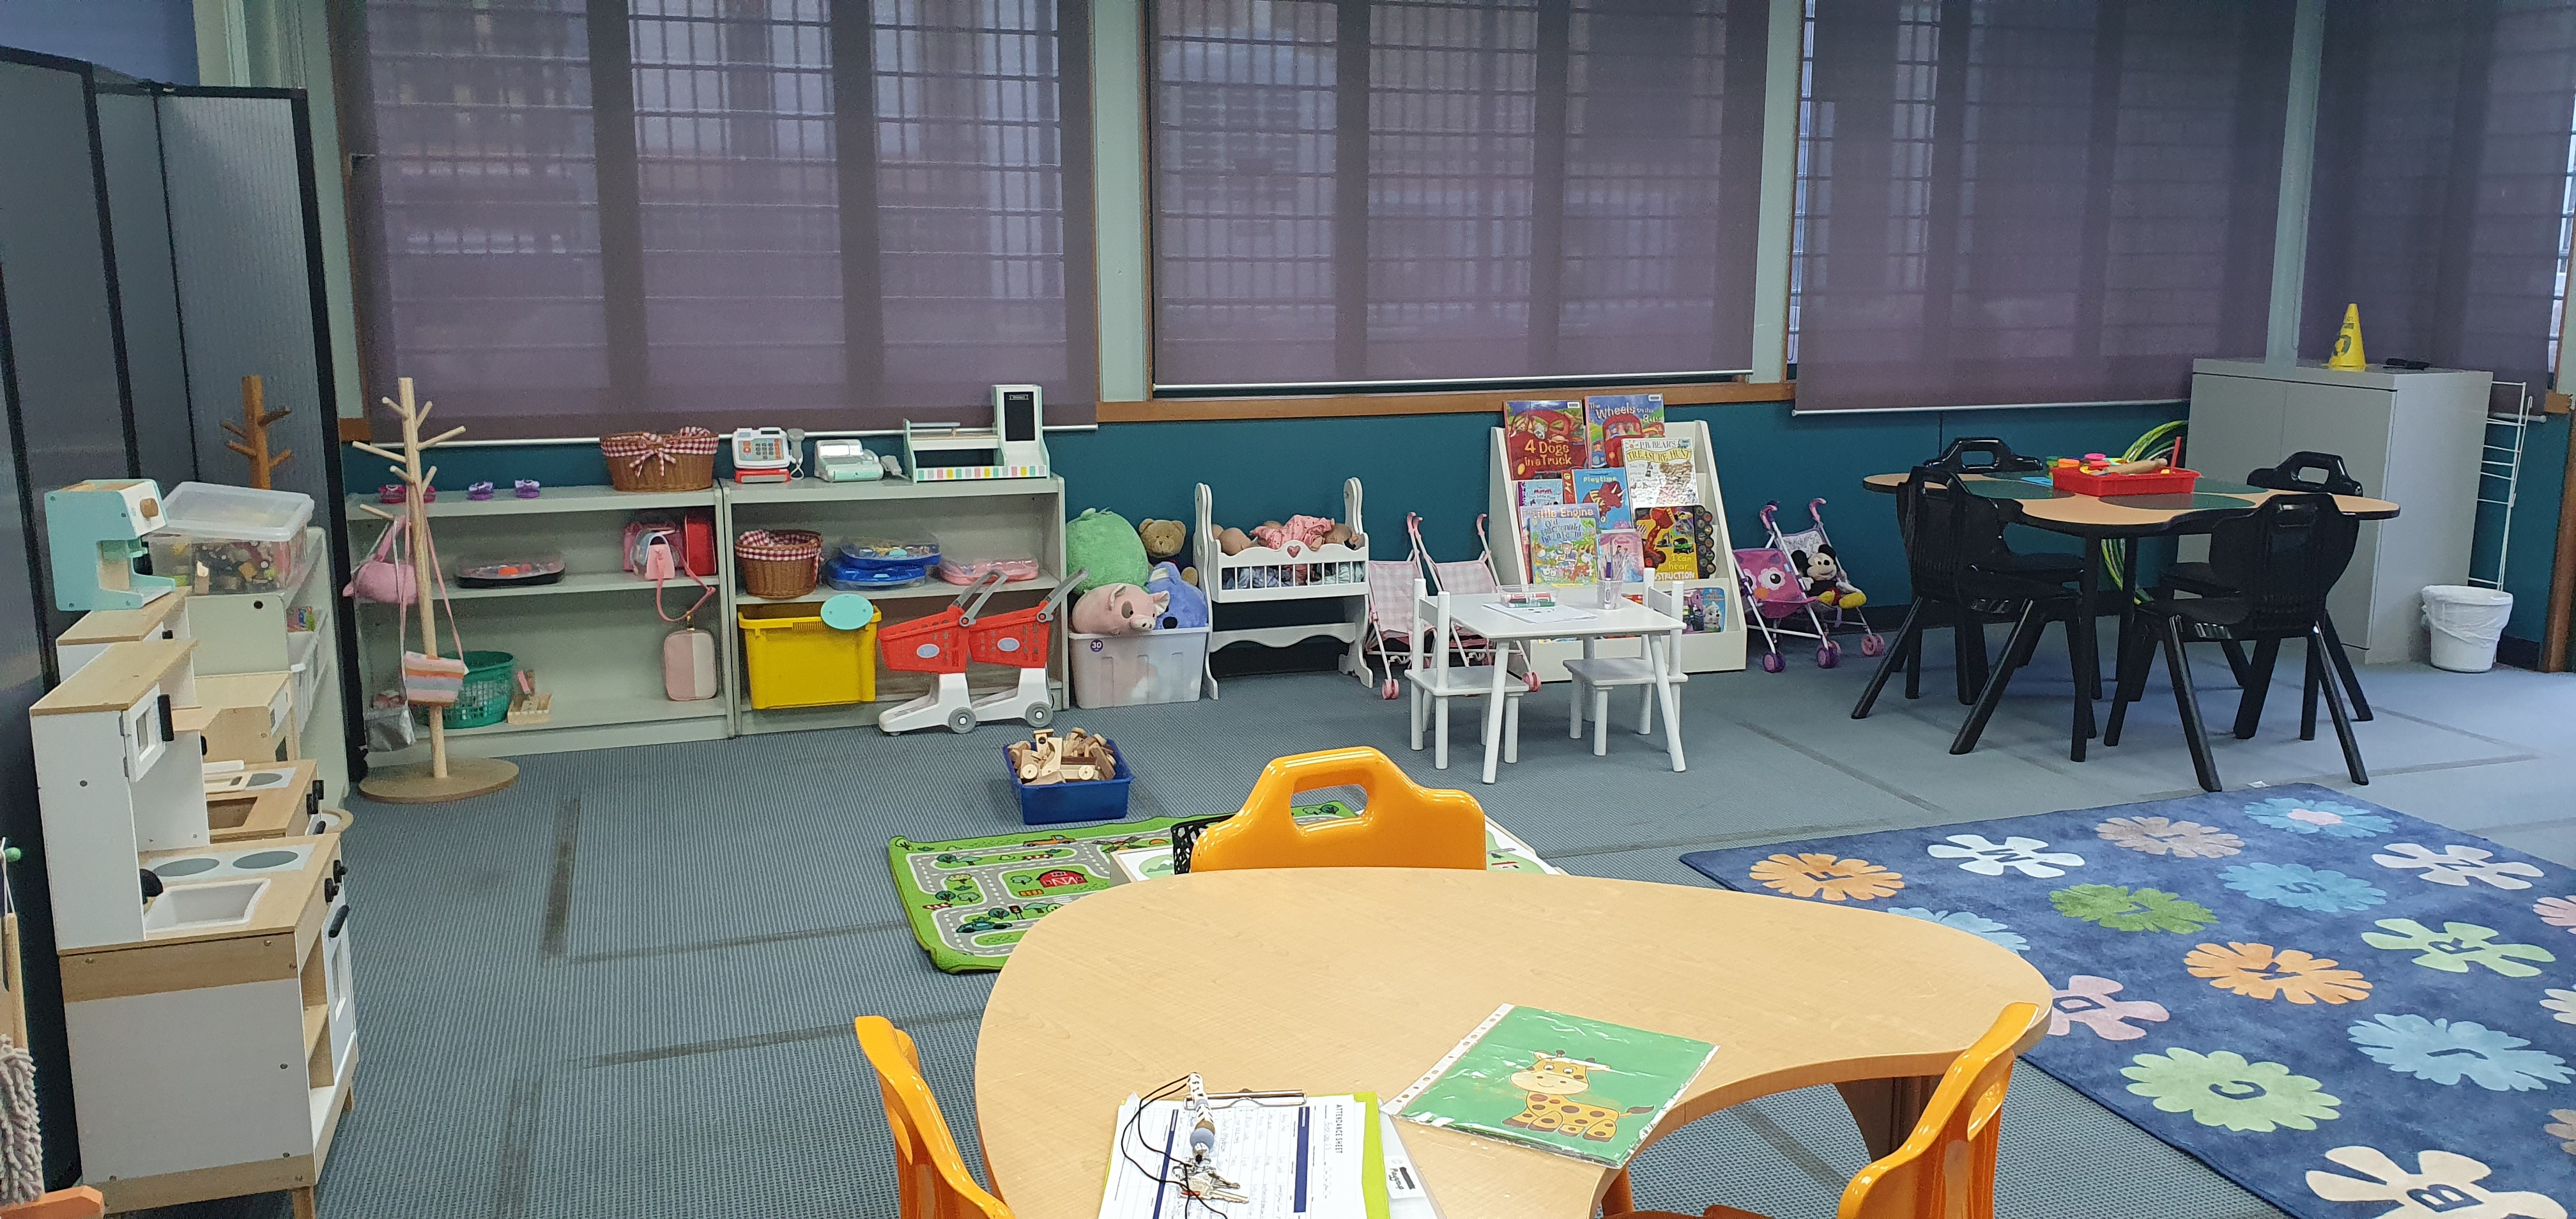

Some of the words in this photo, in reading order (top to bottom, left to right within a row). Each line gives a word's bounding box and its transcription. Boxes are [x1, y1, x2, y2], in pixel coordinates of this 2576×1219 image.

[1596, 402, 1636, 419] Wheels
[1524, 440, 1536, 454] 4
[1538, 441, 1570, 456] Dogs
[1627, 450, 1668, 463] TREASURE
[1669, 449, 1691, 458] HUNT
[1540, 454, 1572, 466] Truck
[1533, 507, 1557, 519] Little
[1560, 507, 1594, 518] Engine
[1655, 571, 1695, 581] STRUCTION
[2052, 996, 2106, 1014] D
[2209, 1080, 2267, 1100] C
[2406, 1184, 2484, 1213] B
